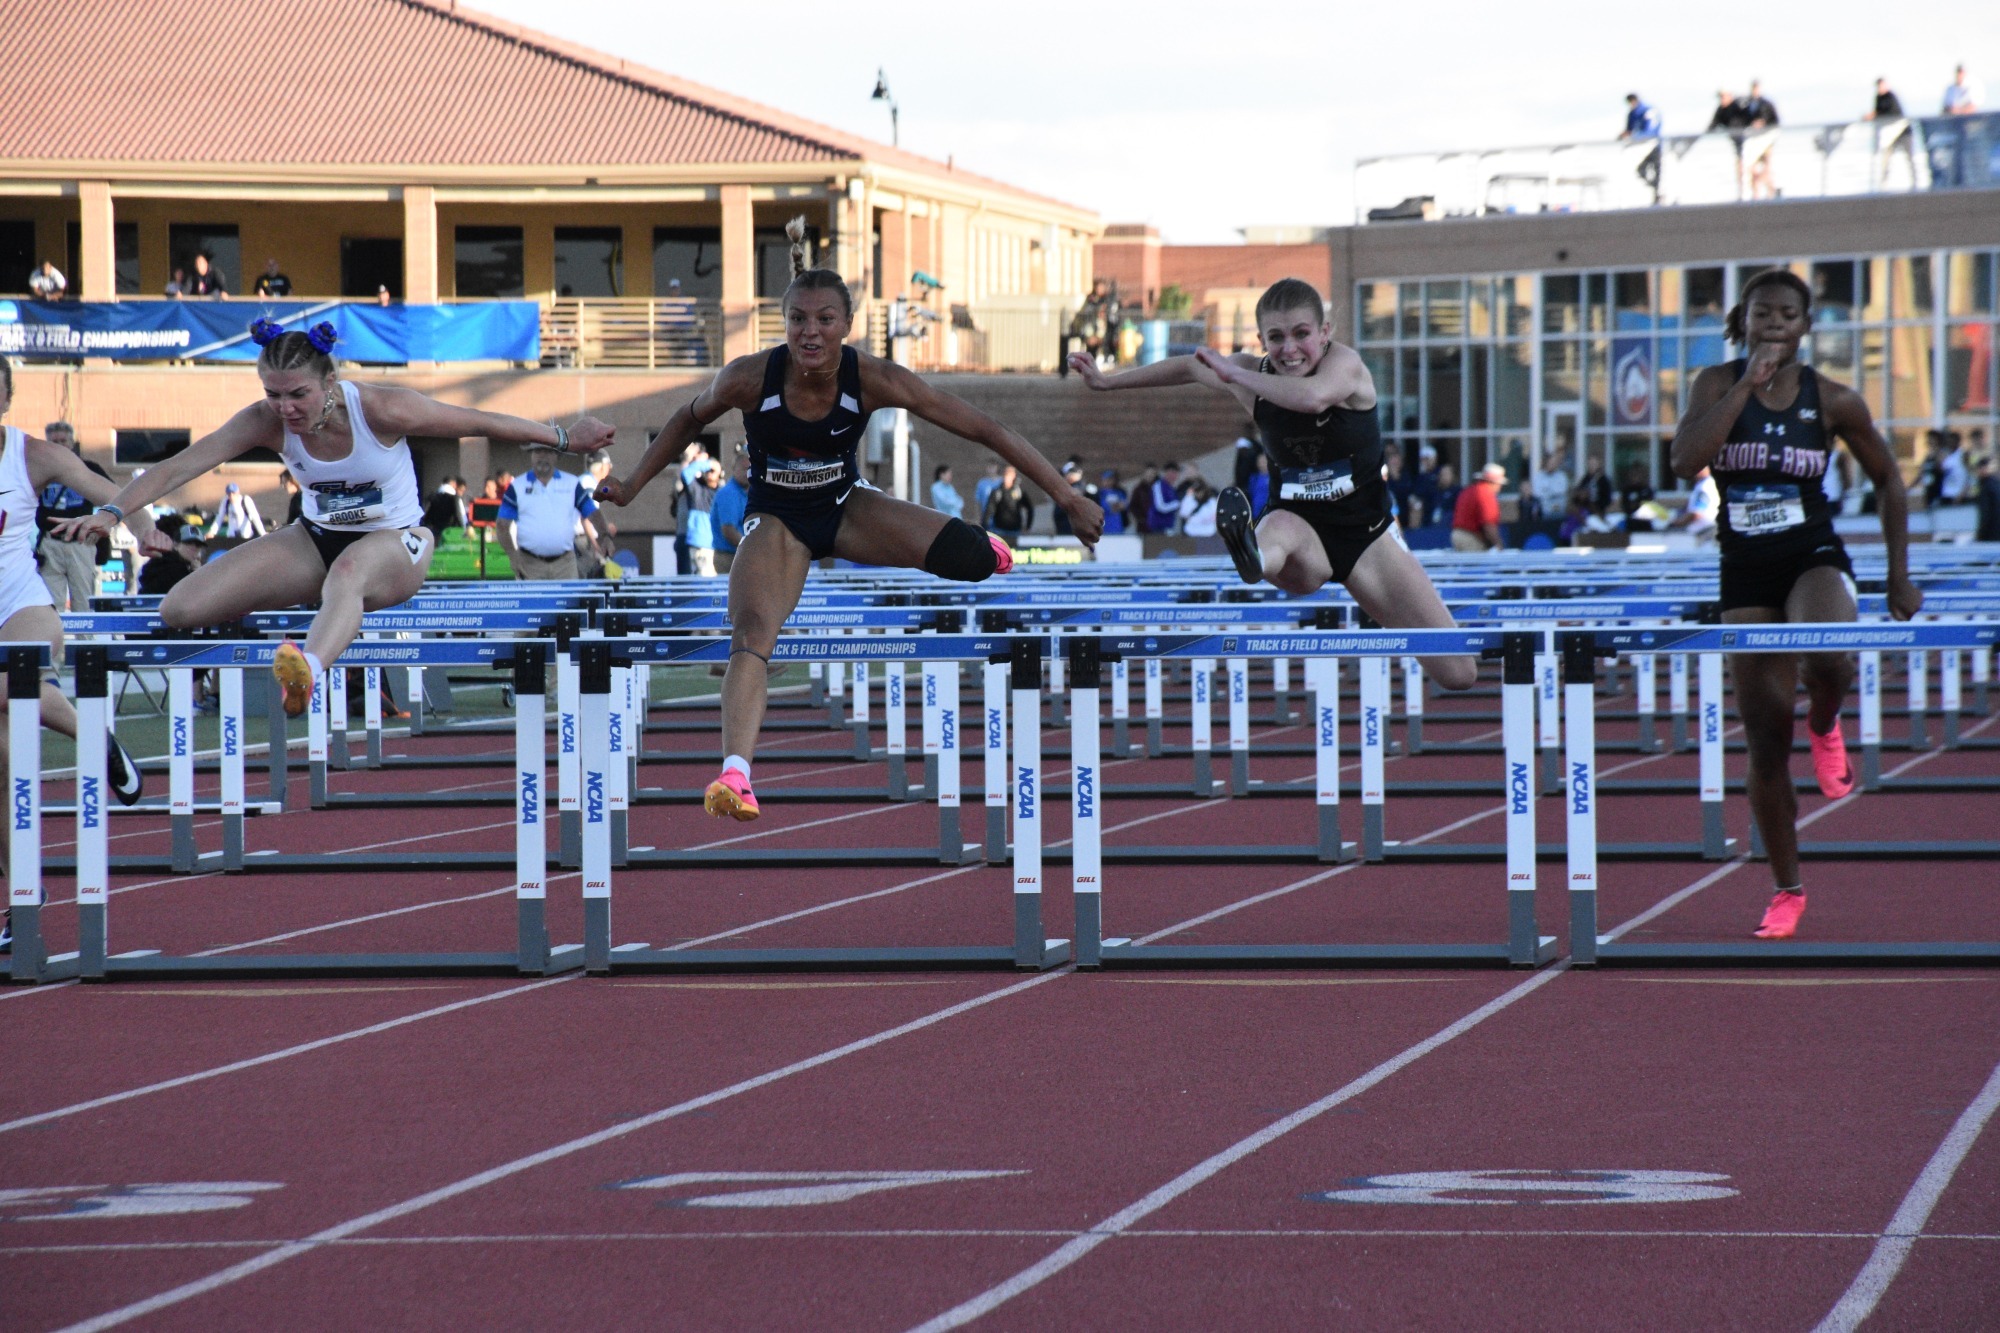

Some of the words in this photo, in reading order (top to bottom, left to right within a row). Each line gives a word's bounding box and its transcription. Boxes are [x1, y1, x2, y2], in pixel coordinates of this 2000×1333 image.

[82, 330, 190, 348] CHAMPIONSHIPS
[771, 468, 838, 484] WILLIAMSON
[1304, 481, 1334, 493] MISSY
[329, 508, 367, 523] BROOKE
[1744, 508, 1789, 528] JONES
[362, 617, 383, 627] RACK
[385, 617, 391, 627] &
[392, 617, 414, 627] FIELD
[415, 616, 483, 627] CHAMPIONSHIPS
[465, 600, 520, 608] CHAMPIONSHIPS
[797, 614, 864, 624] CHAMPIONSHIPS
[1119, 611, 1141, 621] TRACK
[1152, 611, 1174, 620] FIELD
[1175, 610, 1243, 620] CHAMPIONSHIPS
[1497, 607, 1522, 616] TRACK
[1531, 606, 1553, 616] FIELD
[1554, 605, 1624, 616] CHAMPIONSHIPS
[257, 649, 276, 660] TRA
[338, 648, 420, 660] HAMPIONSHIPS
[791, 644, 799, 655] &
[800, 643, 828, 655] FIELD
[830, 642, 917, 655] CHAMPIONSHIPS
[1246, 639, 1279, 650] TRACK
[1281, 639, 1288, 650] &
[1290, 639, 1318, 650] FIELD
[1320, 638, 1407, 650] CHAMPIONSHIPS
[1746, 633, 1781, 645] TRACK
[1782, 633, 1791, 645] &
[1793, 632, 1821, 645] FIELD
[1823, 631, 1915, 644] CHAMPIONSHIPS
[890, 675, 900, 707] NCAA
[926, 674, 936, 707] NCAA
[174, 716, 186, 756] NCAA
[224, 716, 237, 756] NCAA
[562, 712, 574, 753] NCAA
[609, 712, 622, 752] NCAA
[942, 709, 954, 749] NCAA
[988, 708, 1000, 748] NCAA
[1321, 706, 1333, 747] NCAA
[1366, 706, 1378, 747] NCAA
[1705, 702, 1717, 743] NCAA
[15, 777, 32, 830] NCAA
[83, 776, 98, 828] NCAA
[522, 771, 538, 824] NCAA
[587, 771, 603, 823] NCAA
[1018, 766, 1034, 819] NCAA
[1077, 766, 1093, 818] NCAA
[1512, 762, 1528, 815] NCAA
[1572, 762, 1588, 815] NCAA
